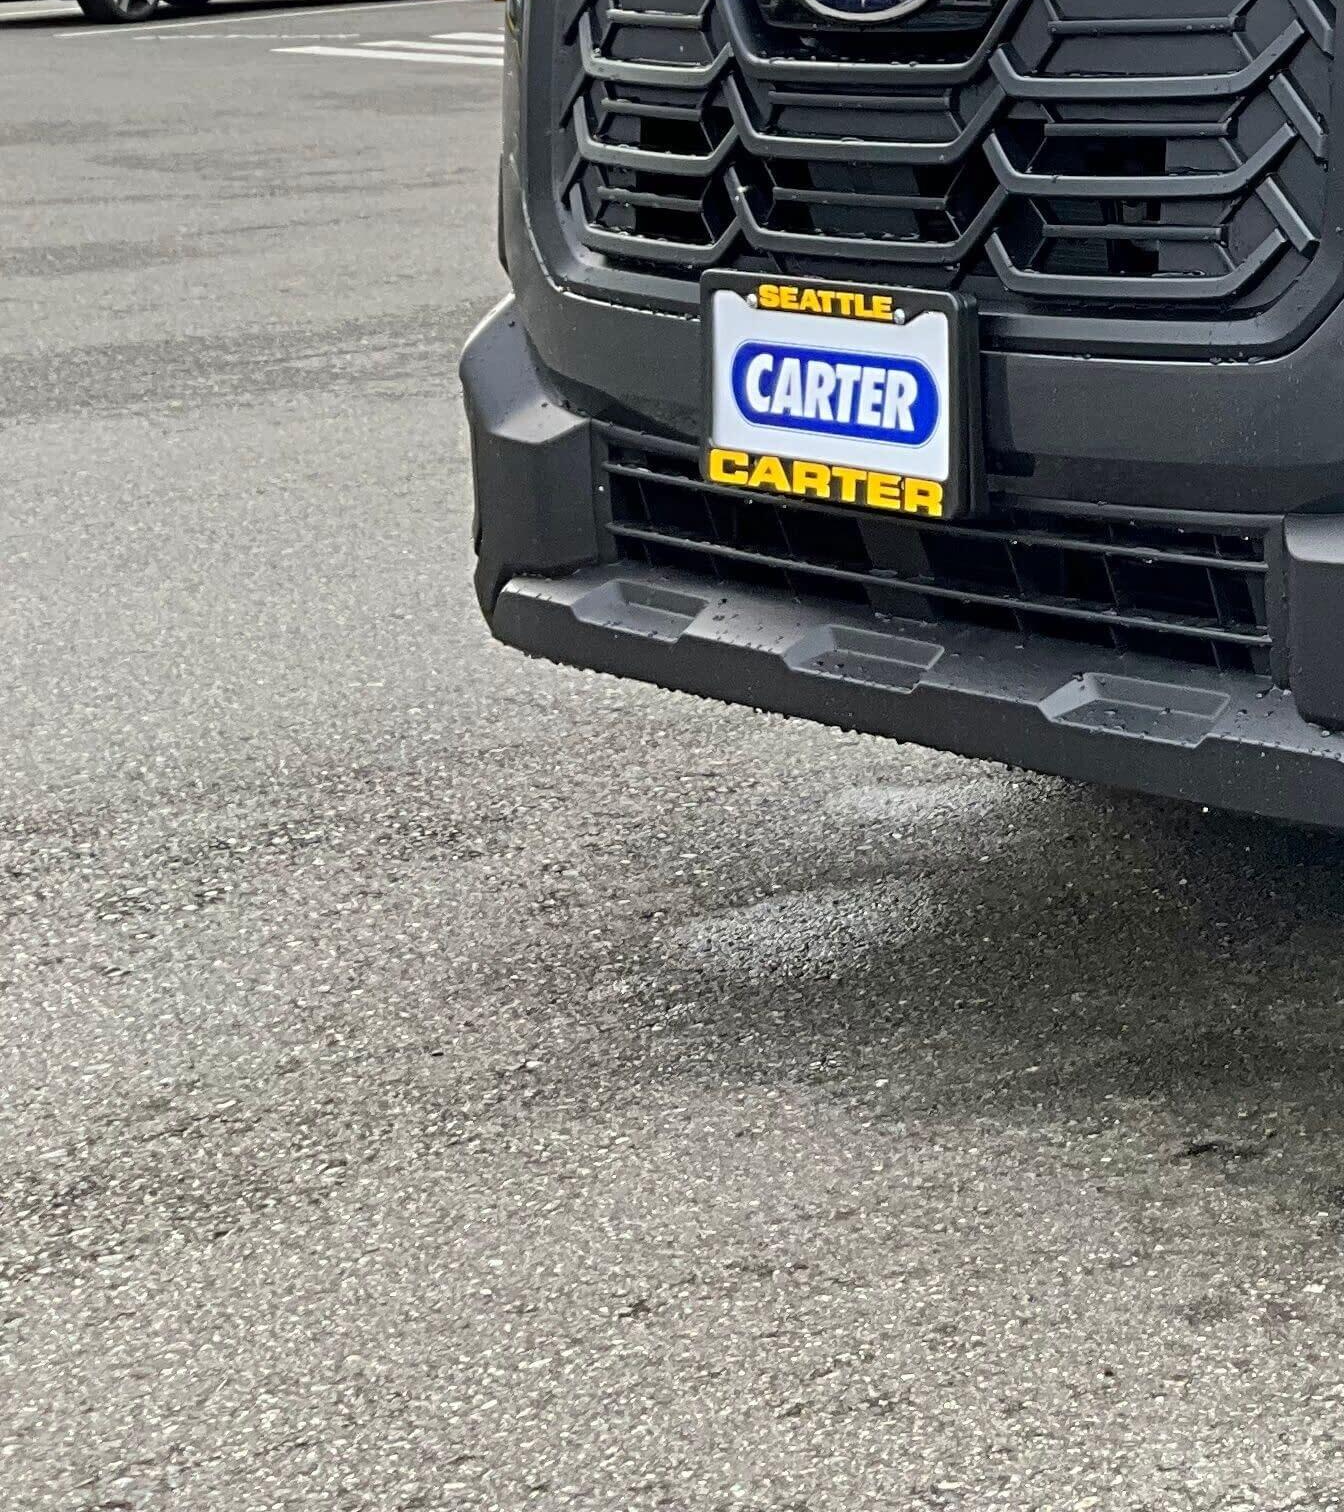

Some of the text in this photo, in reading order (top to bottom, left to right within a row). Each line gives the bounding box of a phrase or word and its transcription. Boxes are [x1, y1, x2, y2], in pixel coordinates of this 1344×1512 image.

[758, 284, 893, 321] SEATTLE
[745, 353, 919, 432] CARTER
[709, 448, 944, 517] CARTER
